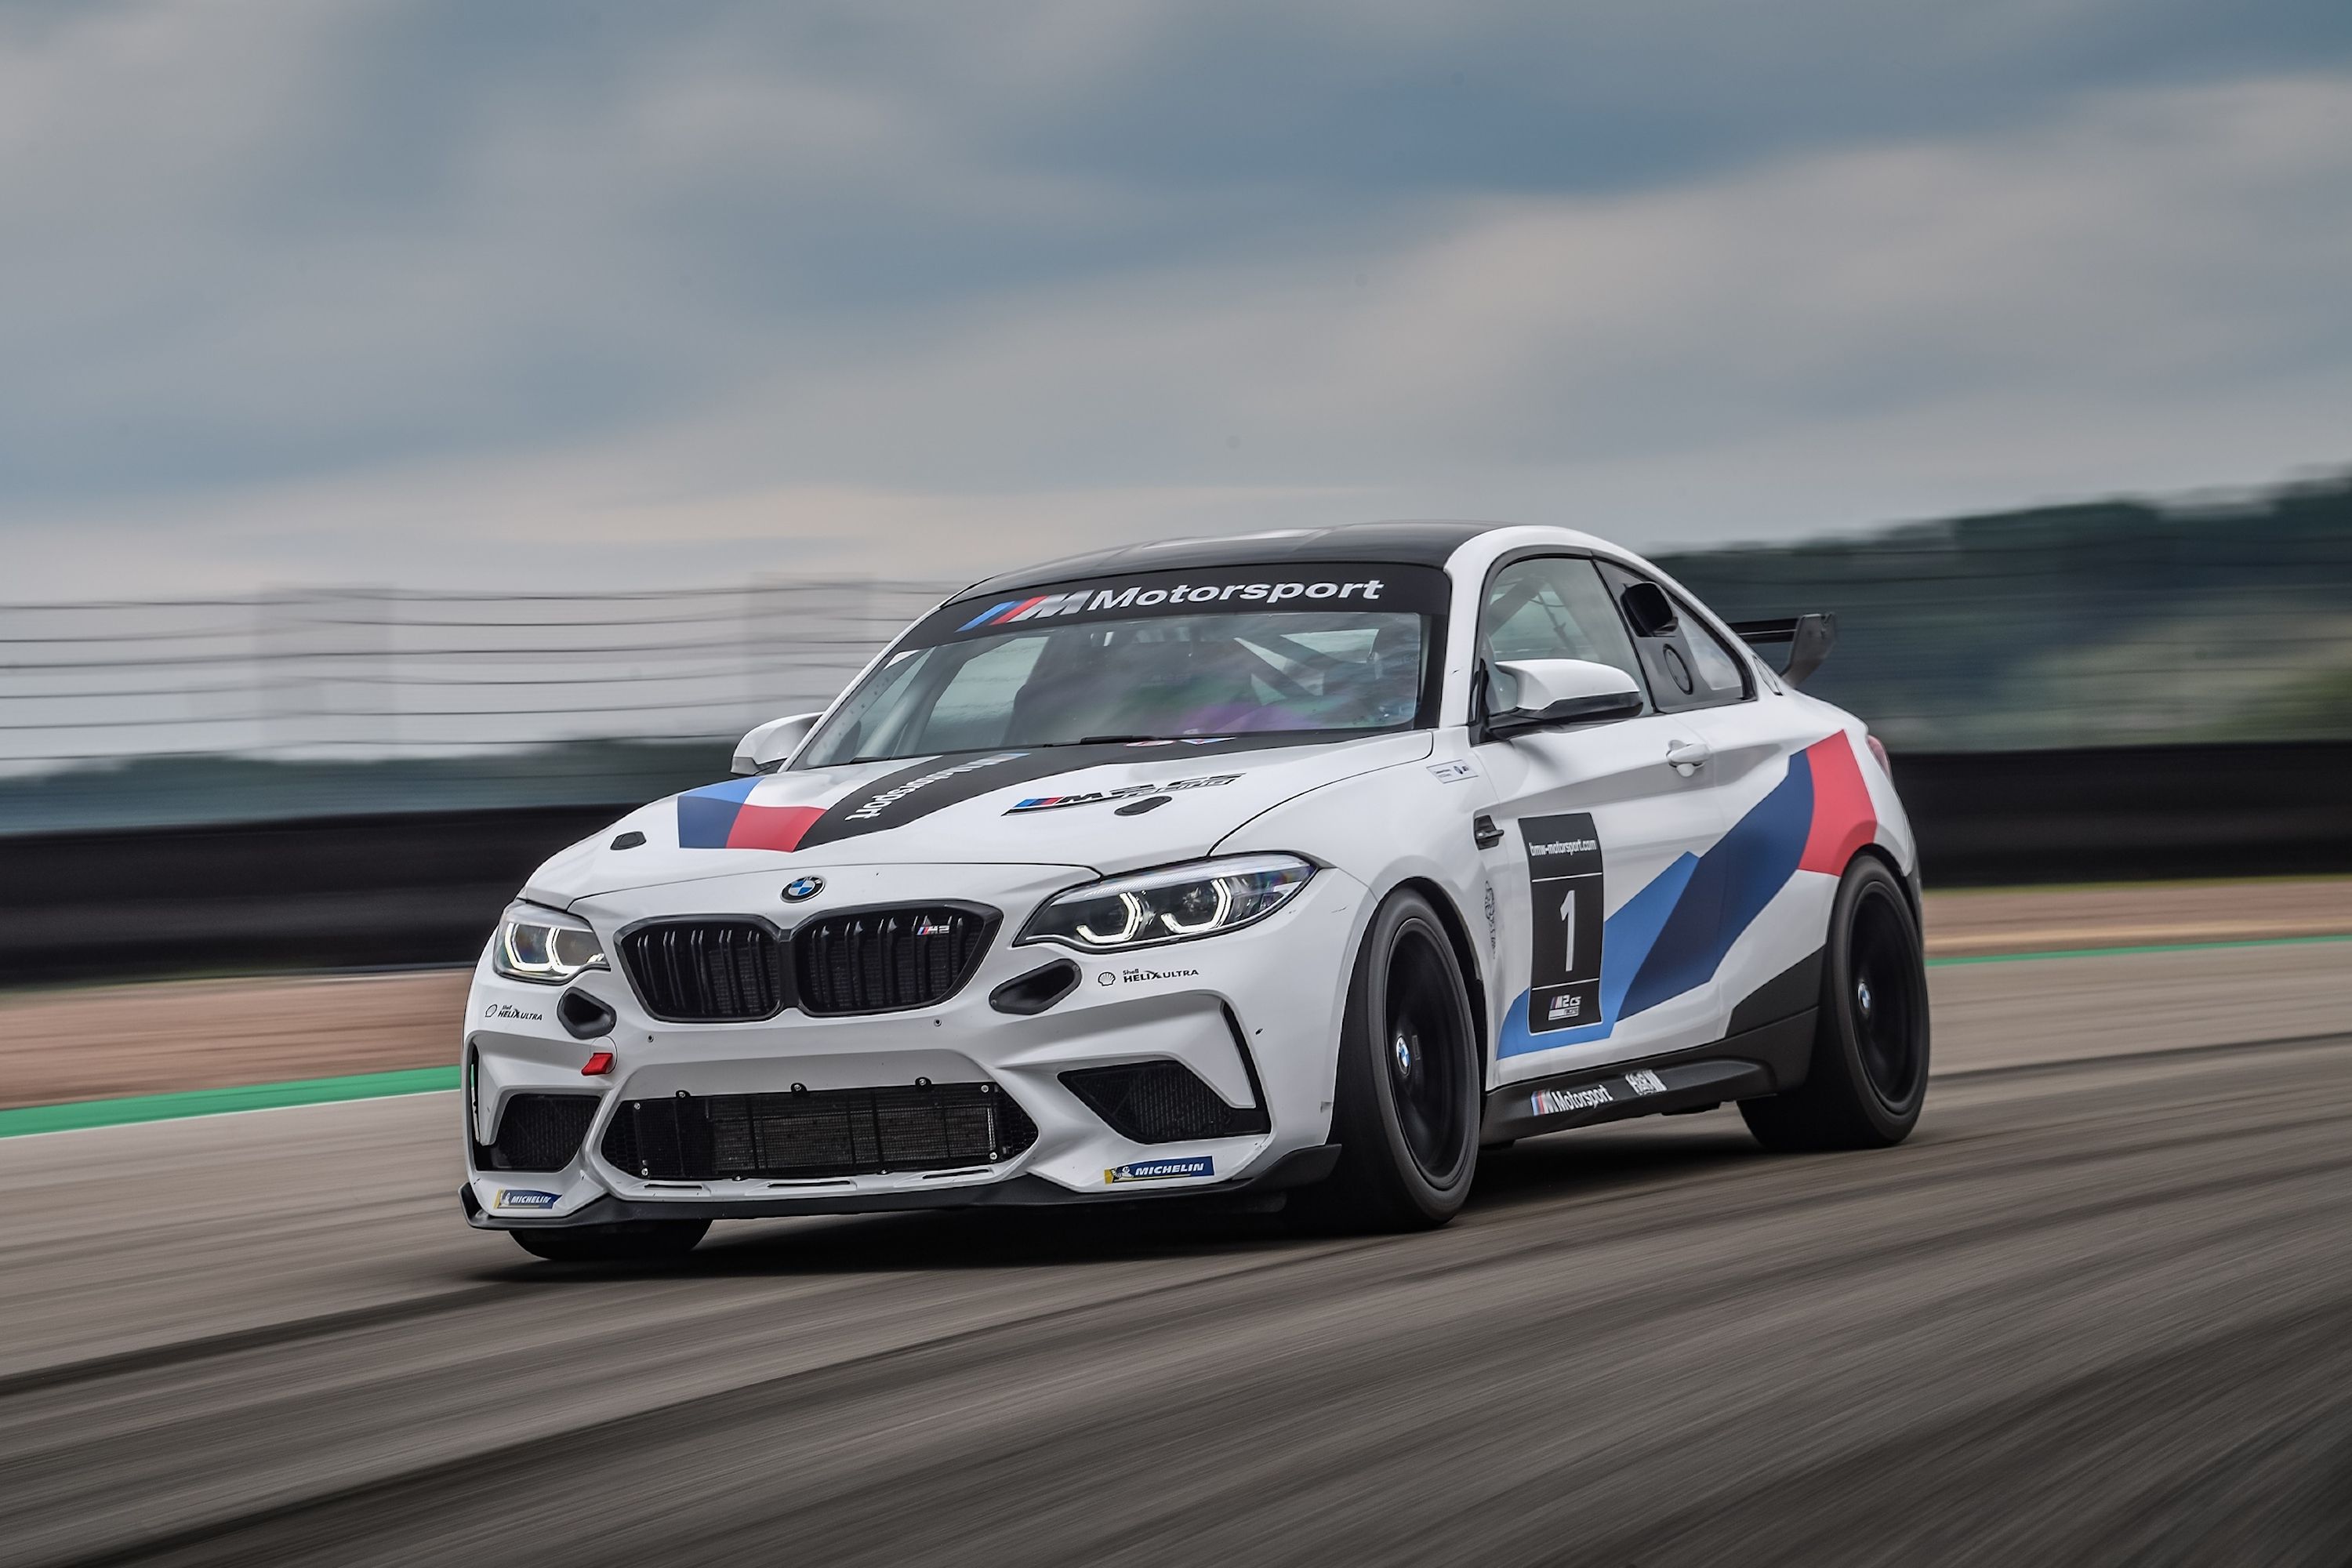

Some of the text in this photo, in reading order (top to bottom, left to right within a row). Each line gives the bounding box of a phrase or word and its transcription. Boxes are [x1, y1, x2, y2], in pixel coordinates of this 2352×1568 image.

[1087, 580, 1385, 612] Motorsport
[1529, 839, 1597, 856] bmw-motorsport.com
[1559, 890, 1575, 972] 1
[1123, 969, 1200, 983] HELIX ULTRA
[498, 1008, 543, 1021] HELIX ULTRA
[1551, 1084, 1613, 1112] Motorsport
[1134, 1163, 1205, 1176] MICHELIN
[510, 1195, 552, 1203] MICHELIN
